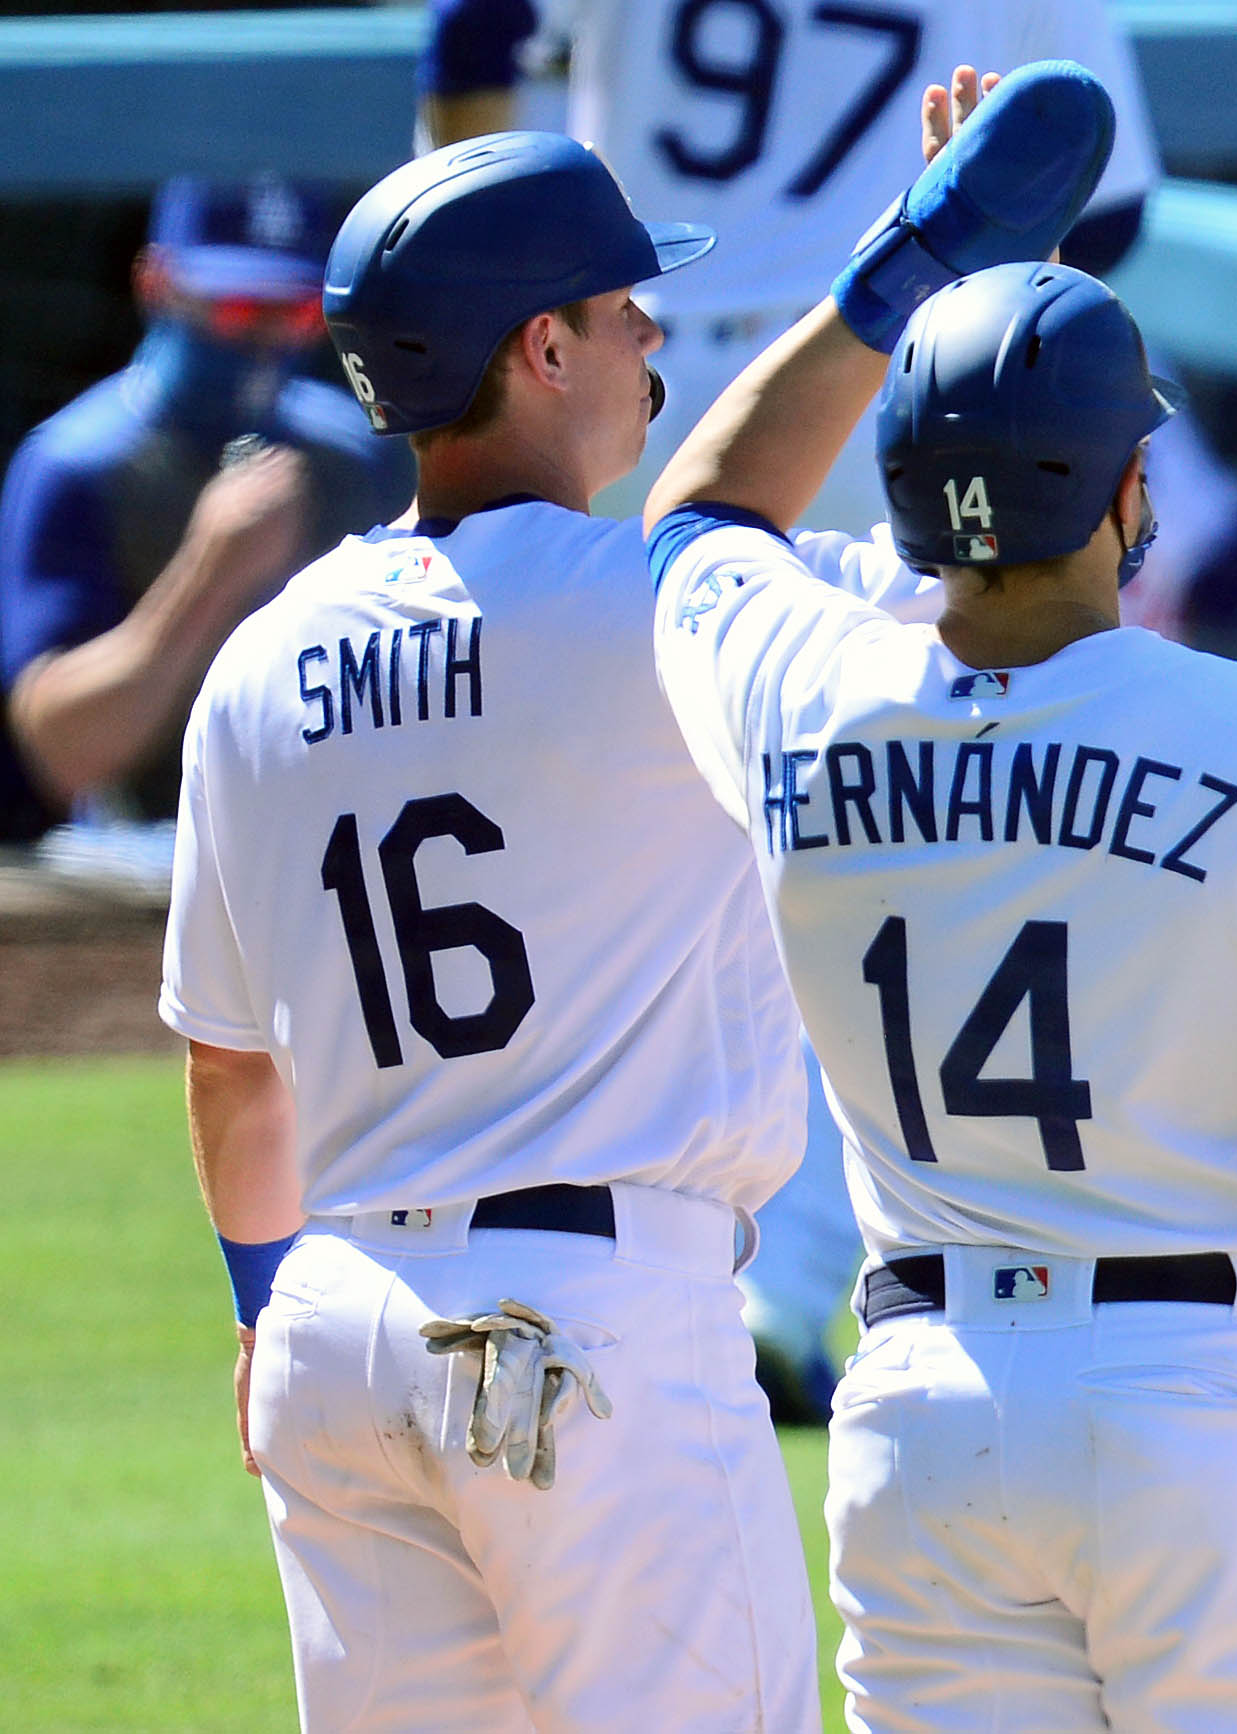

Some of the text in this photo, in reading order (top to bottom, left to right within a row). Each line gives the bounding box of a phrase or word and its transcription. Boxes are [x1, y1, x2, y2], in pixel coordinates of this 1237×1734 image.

[654, 0, 922, 200] 97
[943, 476, 992, 530] 14
[298, 616, 482, 746] SMITH
[321, 792, 536, 1069] 16
[862, 915, 1093, 1171] 14
